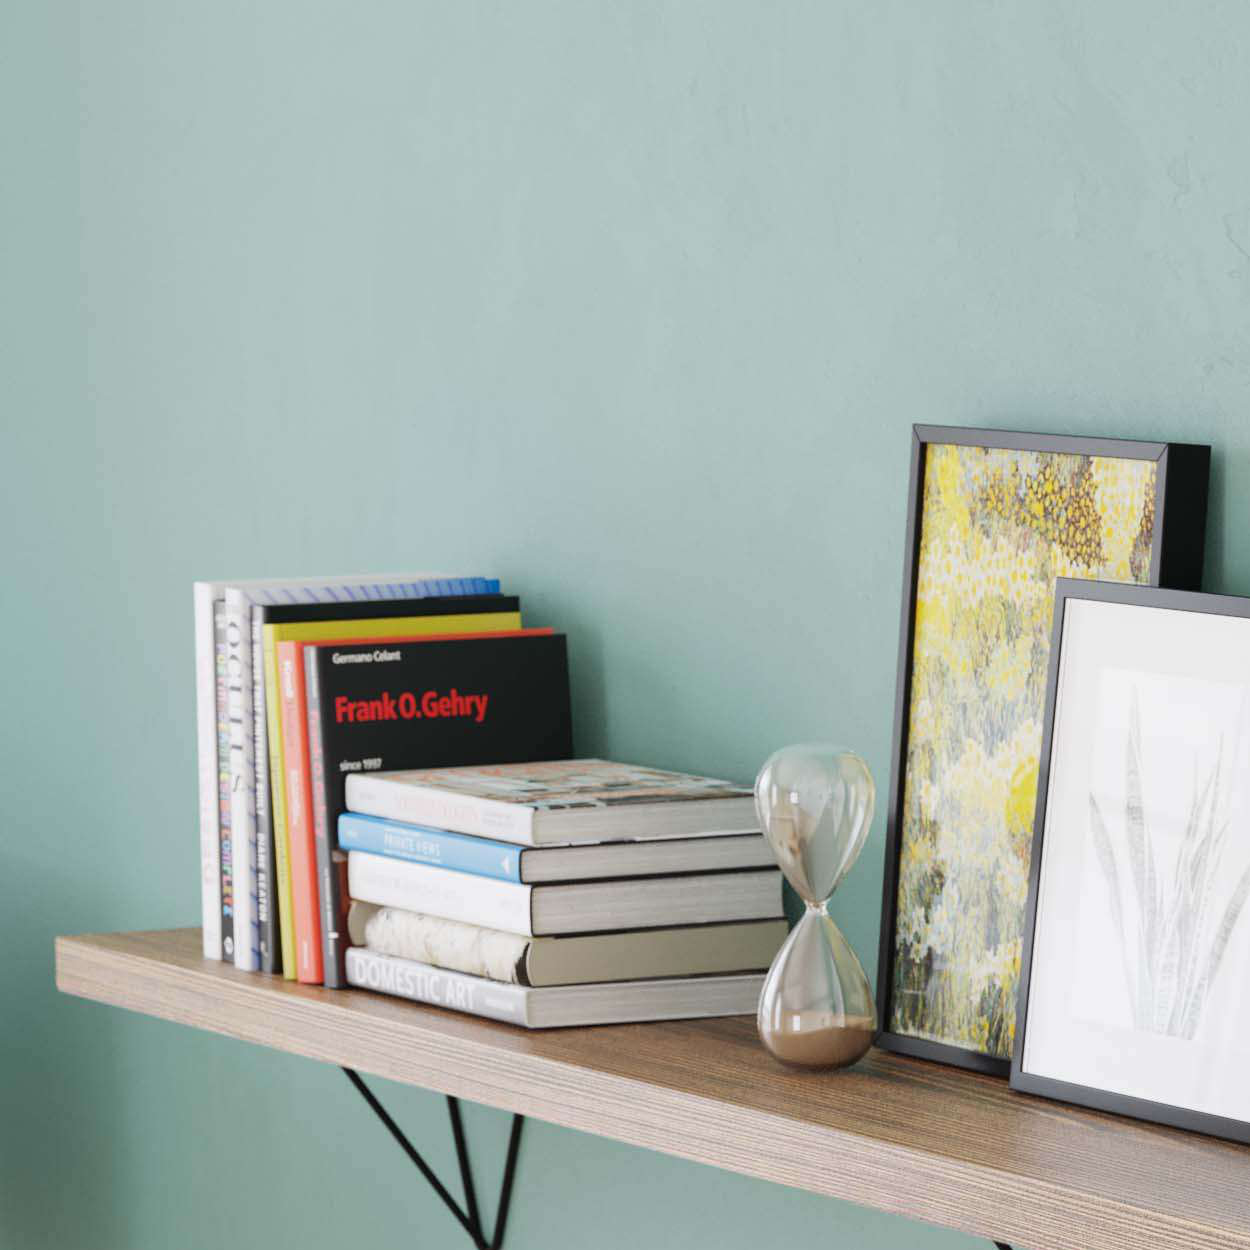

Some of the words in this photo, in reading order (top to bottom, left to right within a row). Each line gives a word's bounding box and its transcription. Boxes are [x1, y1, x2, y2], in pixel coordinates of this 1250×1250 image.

[332, 653, 372, 664] Germano
[335, 691, 398, 723] Frank
[355, 958, 441, 1001] DOMESTIC
[446, 976, 477, 1010] ART
